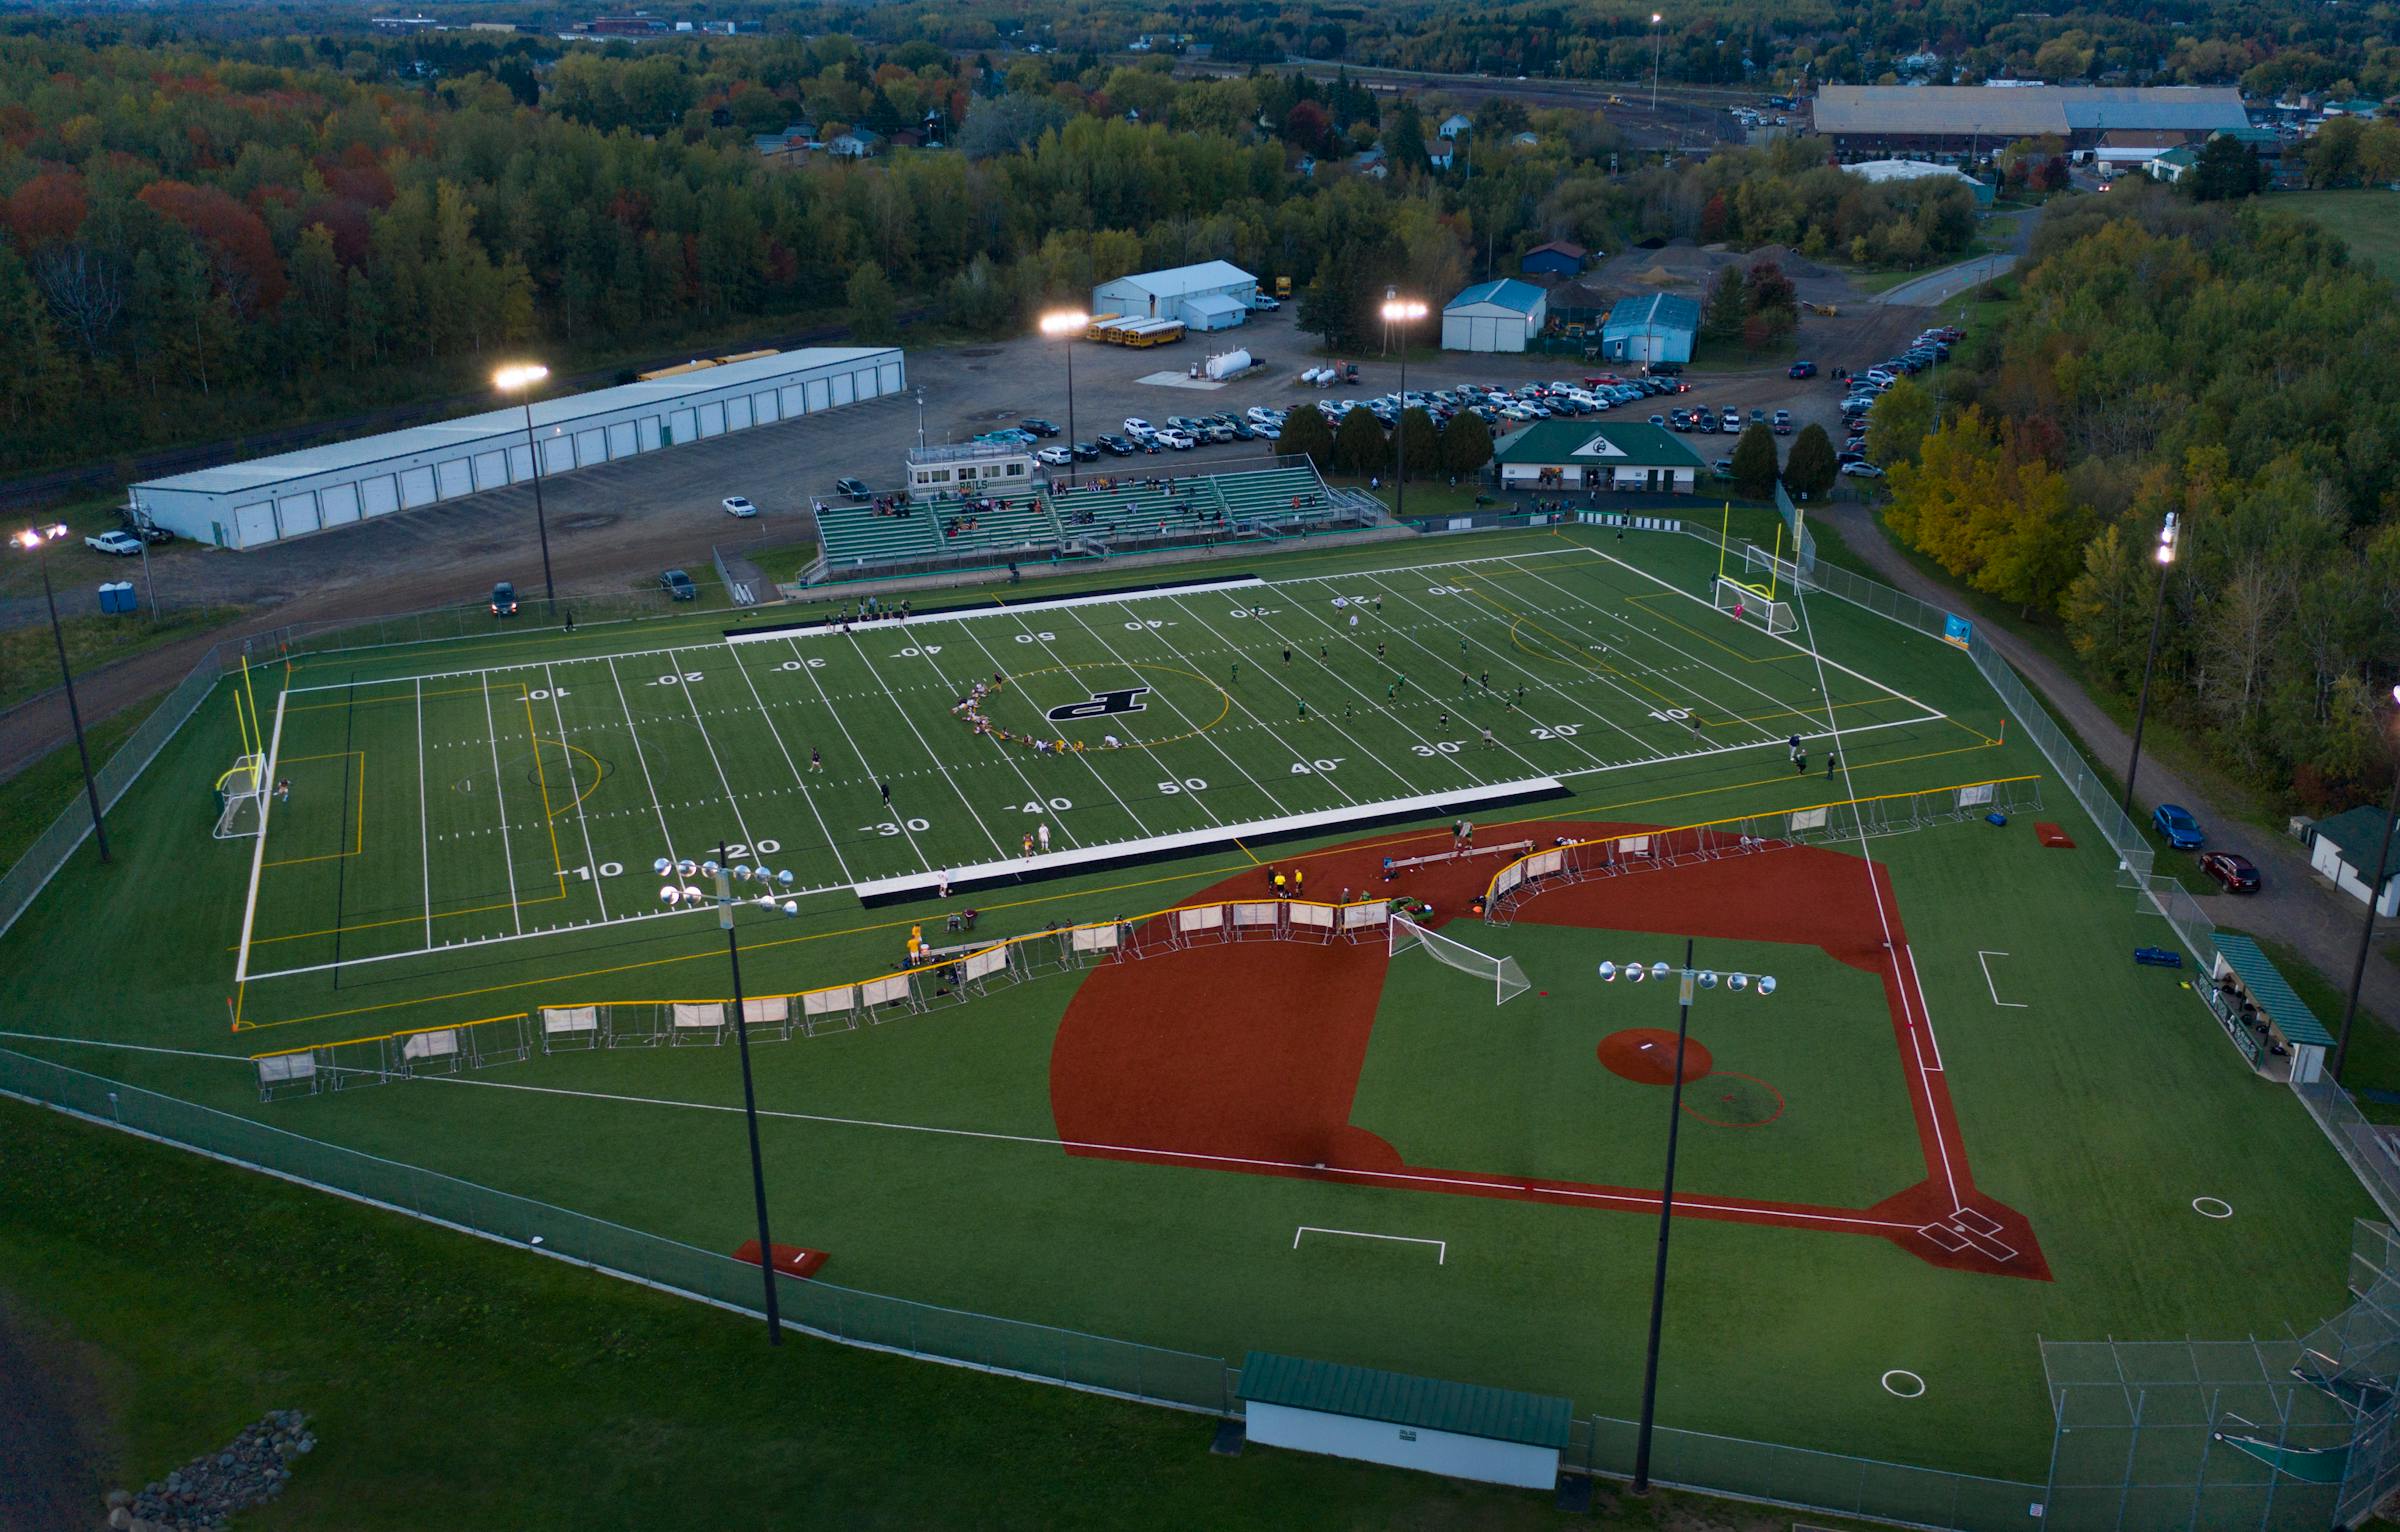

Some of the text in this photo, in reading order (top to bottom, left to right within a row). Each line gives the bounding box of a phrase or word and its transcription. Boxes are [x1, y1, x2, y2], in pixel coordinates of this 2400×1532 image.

[960, 481, 988, 490] RAILS
[1125, 620, 1163, 631] 40
[1015, 632, 1056, 643] 50
[901, 645, 942, 657] 40
[782, 658, 827, 671] 30
[658, 671, 705, 685] 20
[529, 687, 571, 700] 10
[1647, 709, 1689, 722] 10
[1529, 724, 1578, 740] 20
[1411, 741, 1461, 757] 30
[1291, 759, 1337, 774] 40
[1157, 777, 1208, 794] 50
[1022, 797, 1073, 814] 40
[876, 818, 930, 836] 30
[724, 839, 780, 859] 20
[572, 862, 624, 881] 10
